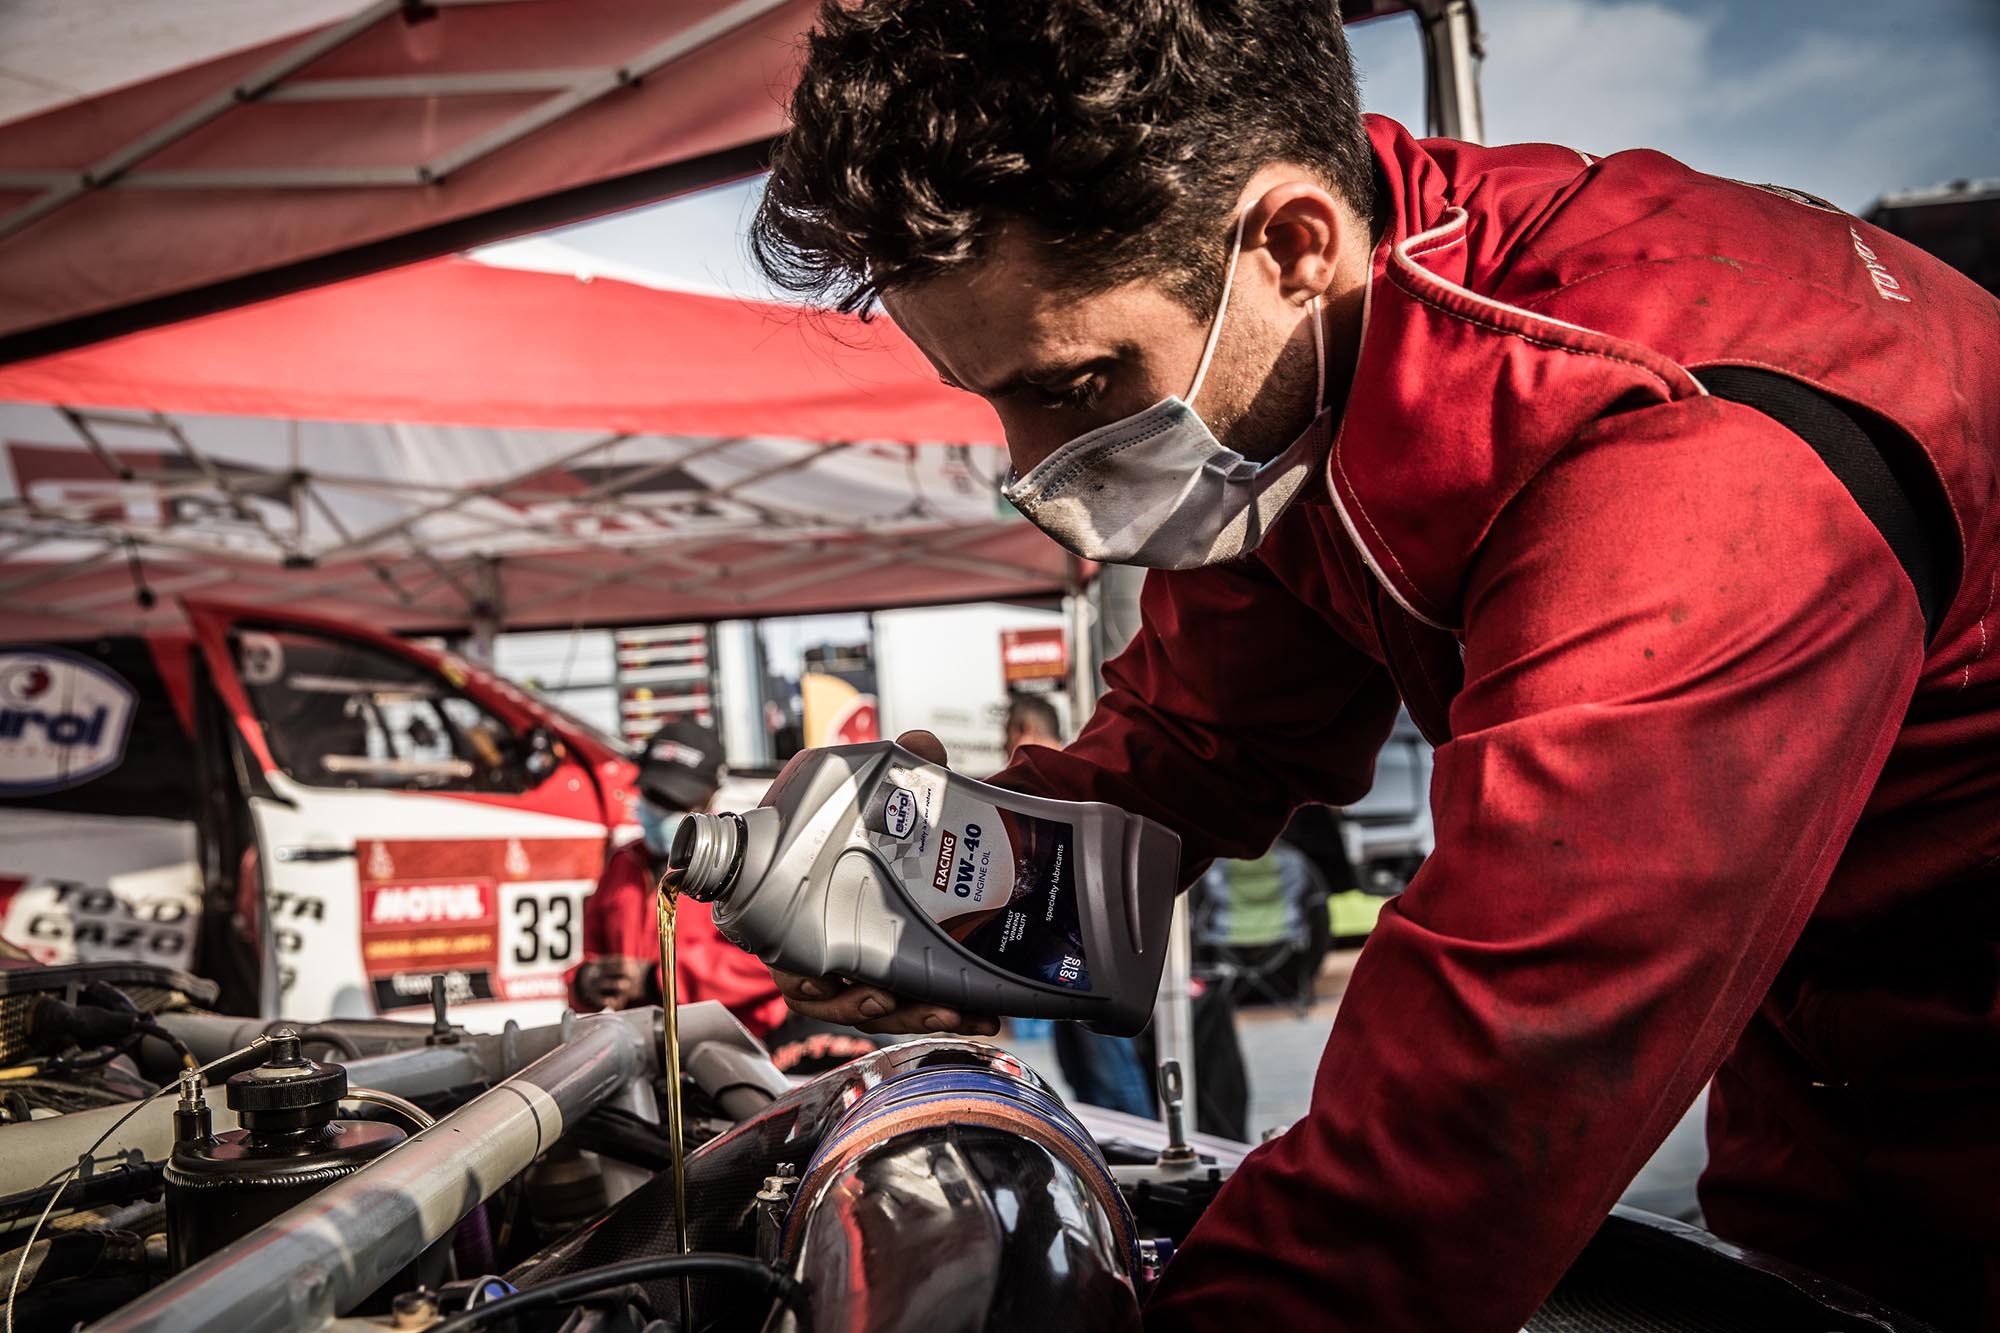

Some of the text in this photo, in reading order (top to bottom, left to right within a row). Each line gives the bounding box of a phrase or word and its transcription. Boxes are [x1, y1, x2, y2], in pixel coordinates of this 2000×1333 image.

[1849, 225, 1911, 302] TOYOT
[896, 792, 909, 833] eurol
[936, 836, 954, 887] RACING
[954, 823, 982, 898] 0W-40
[974, 850, 991, 902] ENGINE OIL
[371, 884, 485, 924] MOTUL
[1045, 844, 1064, 922] specialty lubricants
[514, 896, 572, 963] 33
[999, 935, 1008, 952] RACE
[1005, 909, 1014, 930] RALLY
[1009, 912, 1020, 941] WINNING
[1016, 913, 1027, 941] QUALITY
[1060, 954, 1073, 978] SYN
[1069, 958, 1081, 980] GIS
